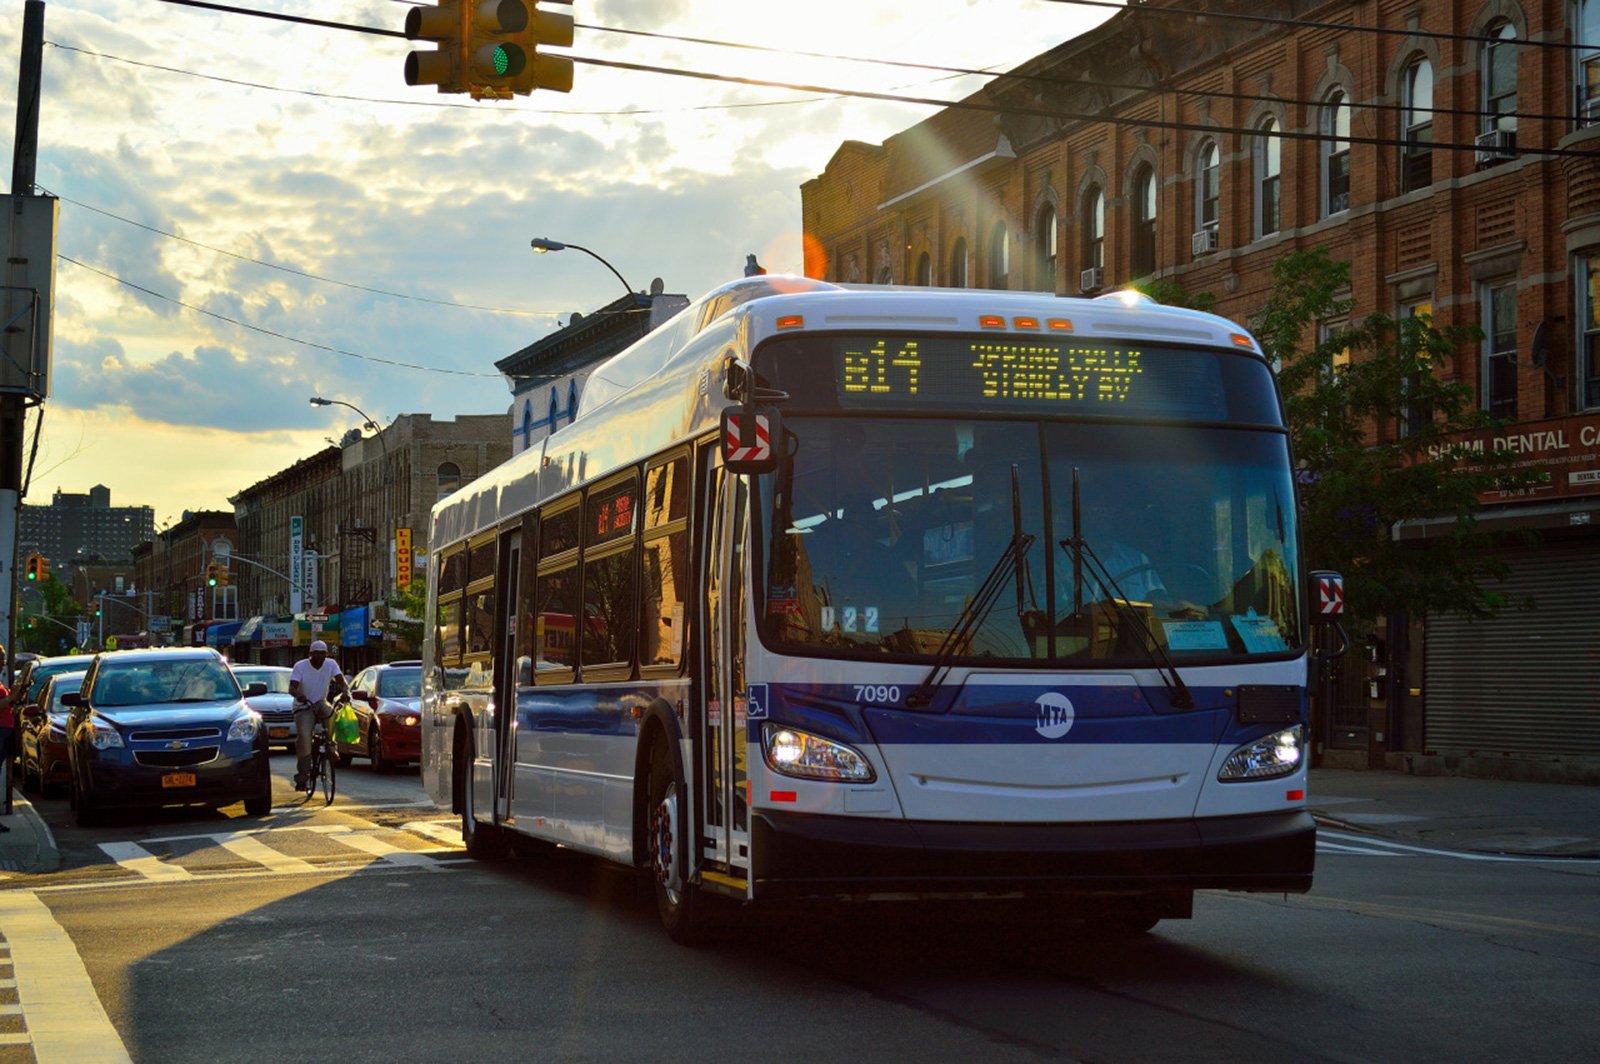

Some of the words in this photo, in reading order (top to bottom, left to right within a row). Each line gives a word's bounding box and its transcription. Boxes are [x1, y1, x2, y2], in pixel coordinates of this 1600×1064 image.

[846, 341, 921, 393] B14
[983, 371, 1088, 399] STANLEY
[1099, 376, 1131, 401] AV
[1493, 430, 1570, 455] DENTAL
[853, 685, 900, 702] 7090
[1035, 703, 1067, 728] MTA
